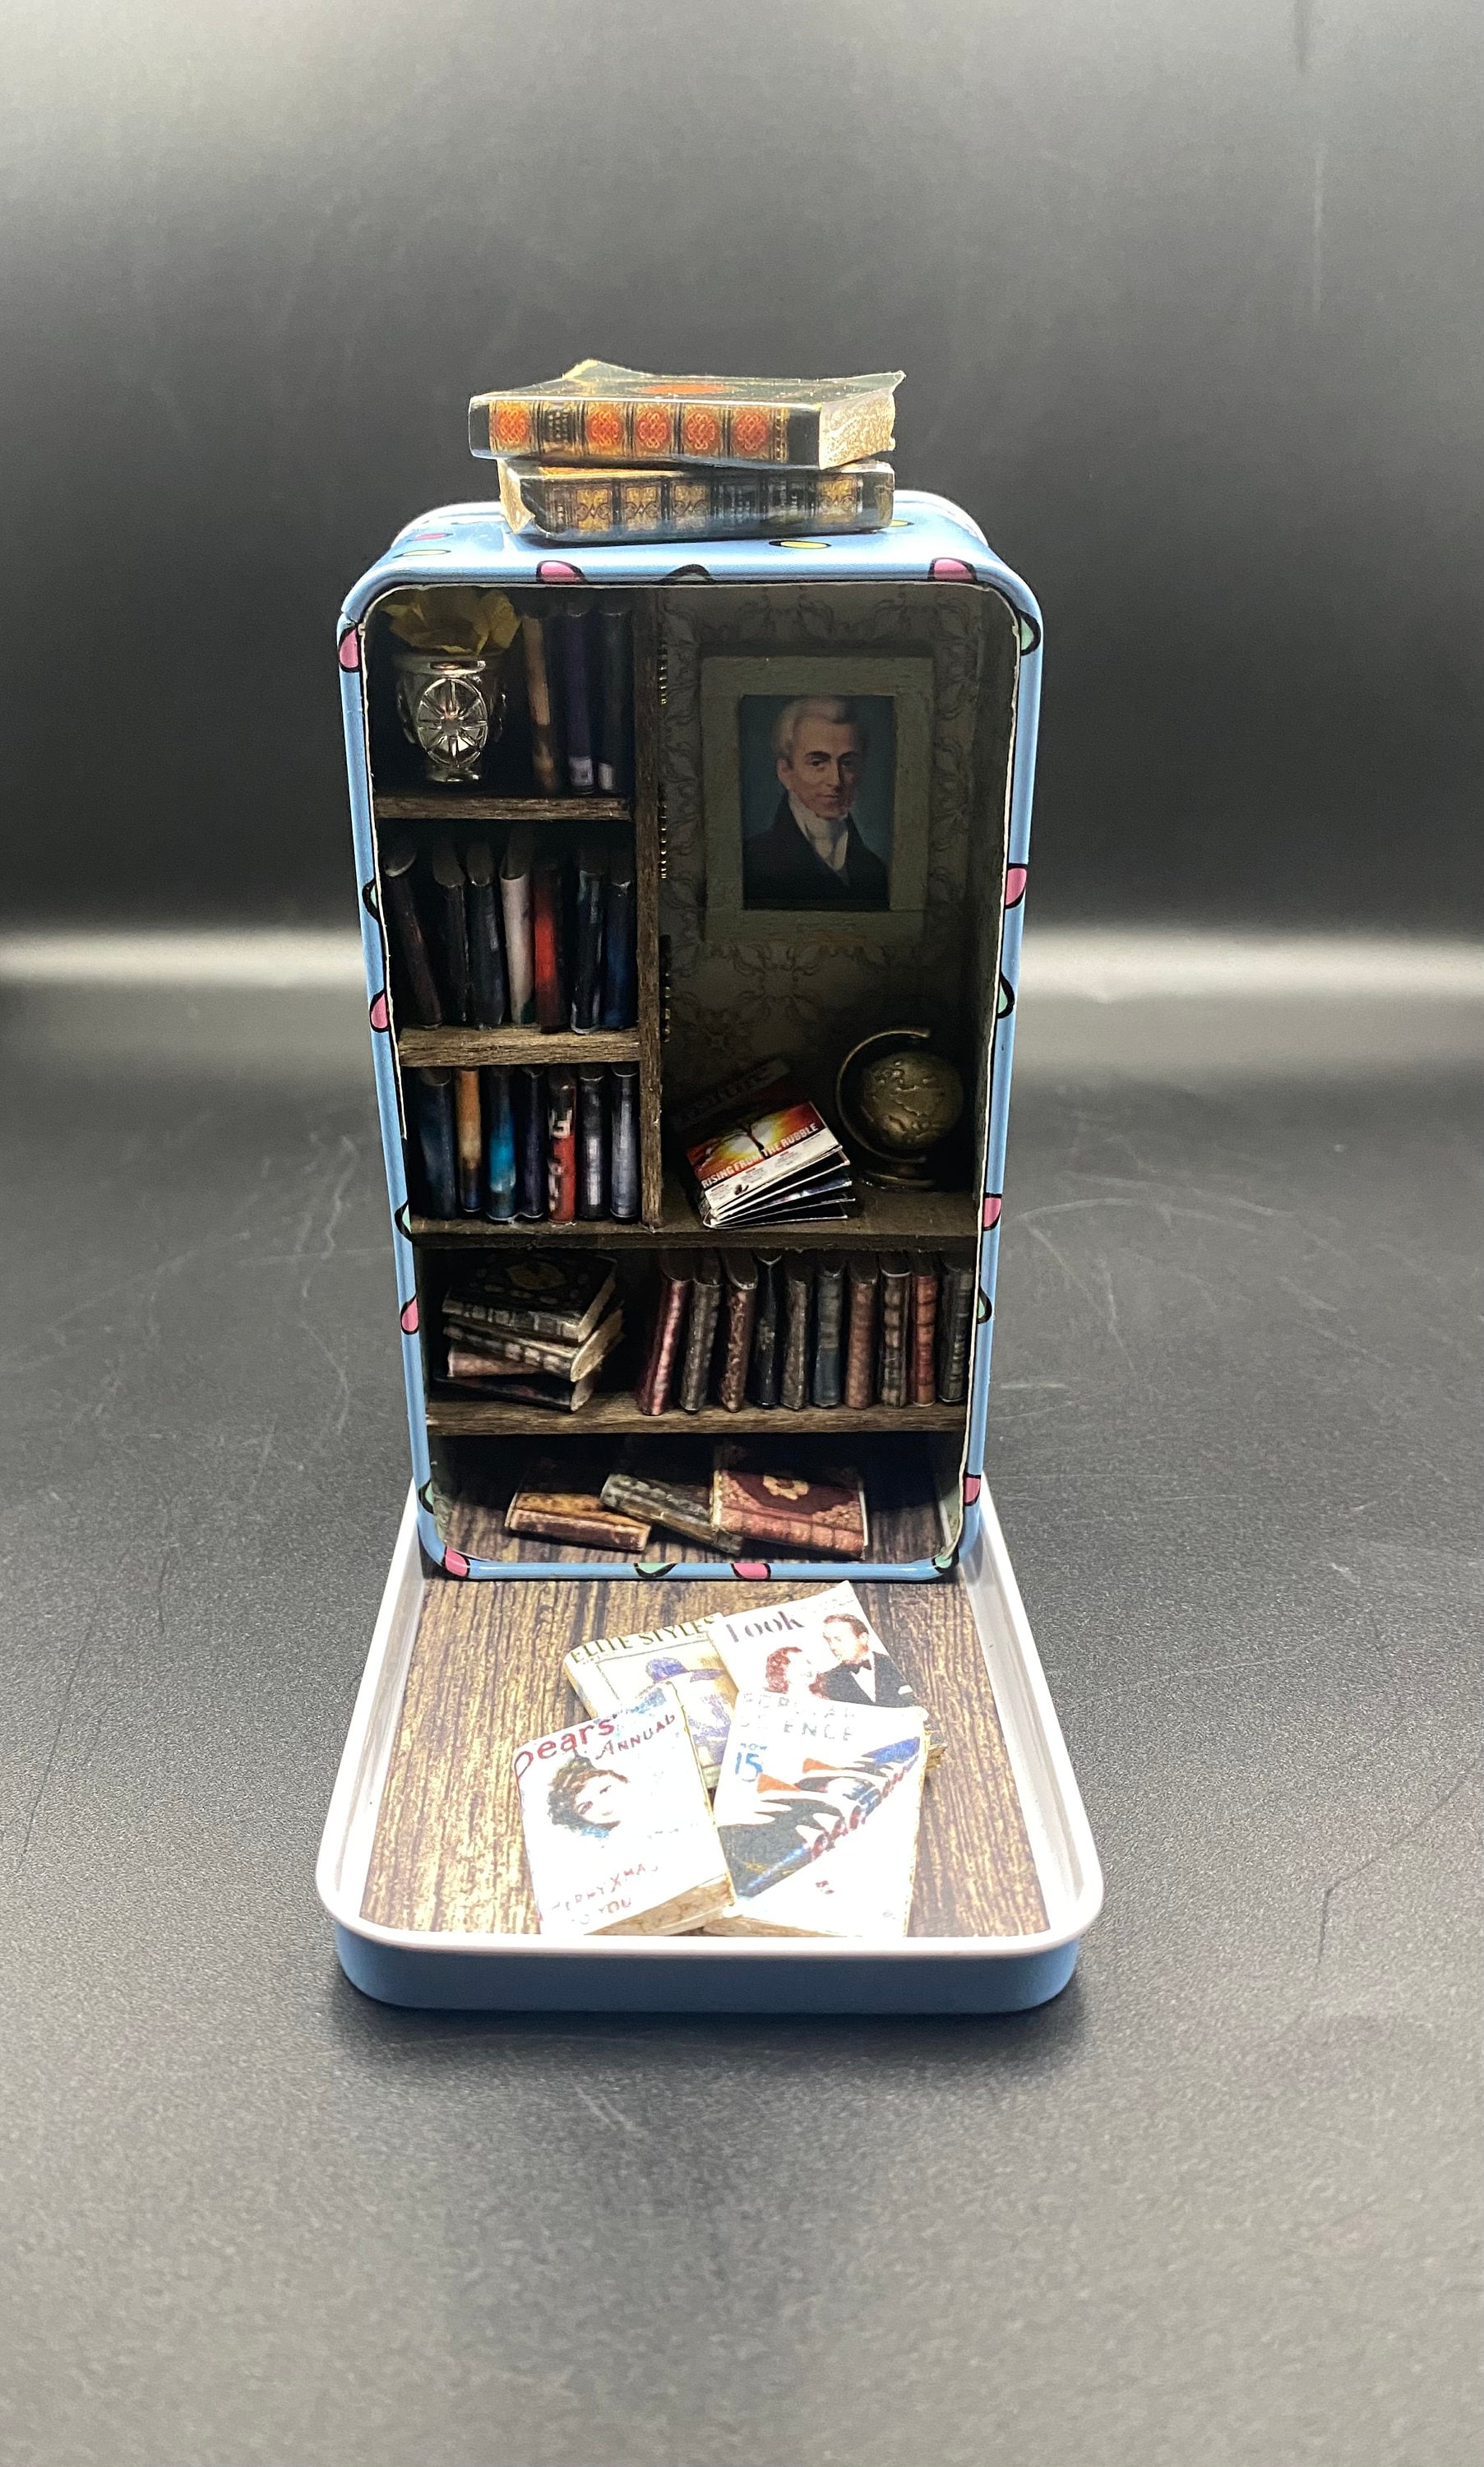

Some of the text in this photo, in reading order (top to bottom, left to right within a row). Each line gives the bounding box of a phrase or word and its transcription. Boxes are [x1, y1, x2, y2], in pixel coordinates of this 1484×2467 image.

[701, 1165, 734, 1189] RISING
[733, 1155, 764, 1176] FROM
[761, 1142, 782, 1157] THE
[781, 1122, 819, 1148] RUBBLE
